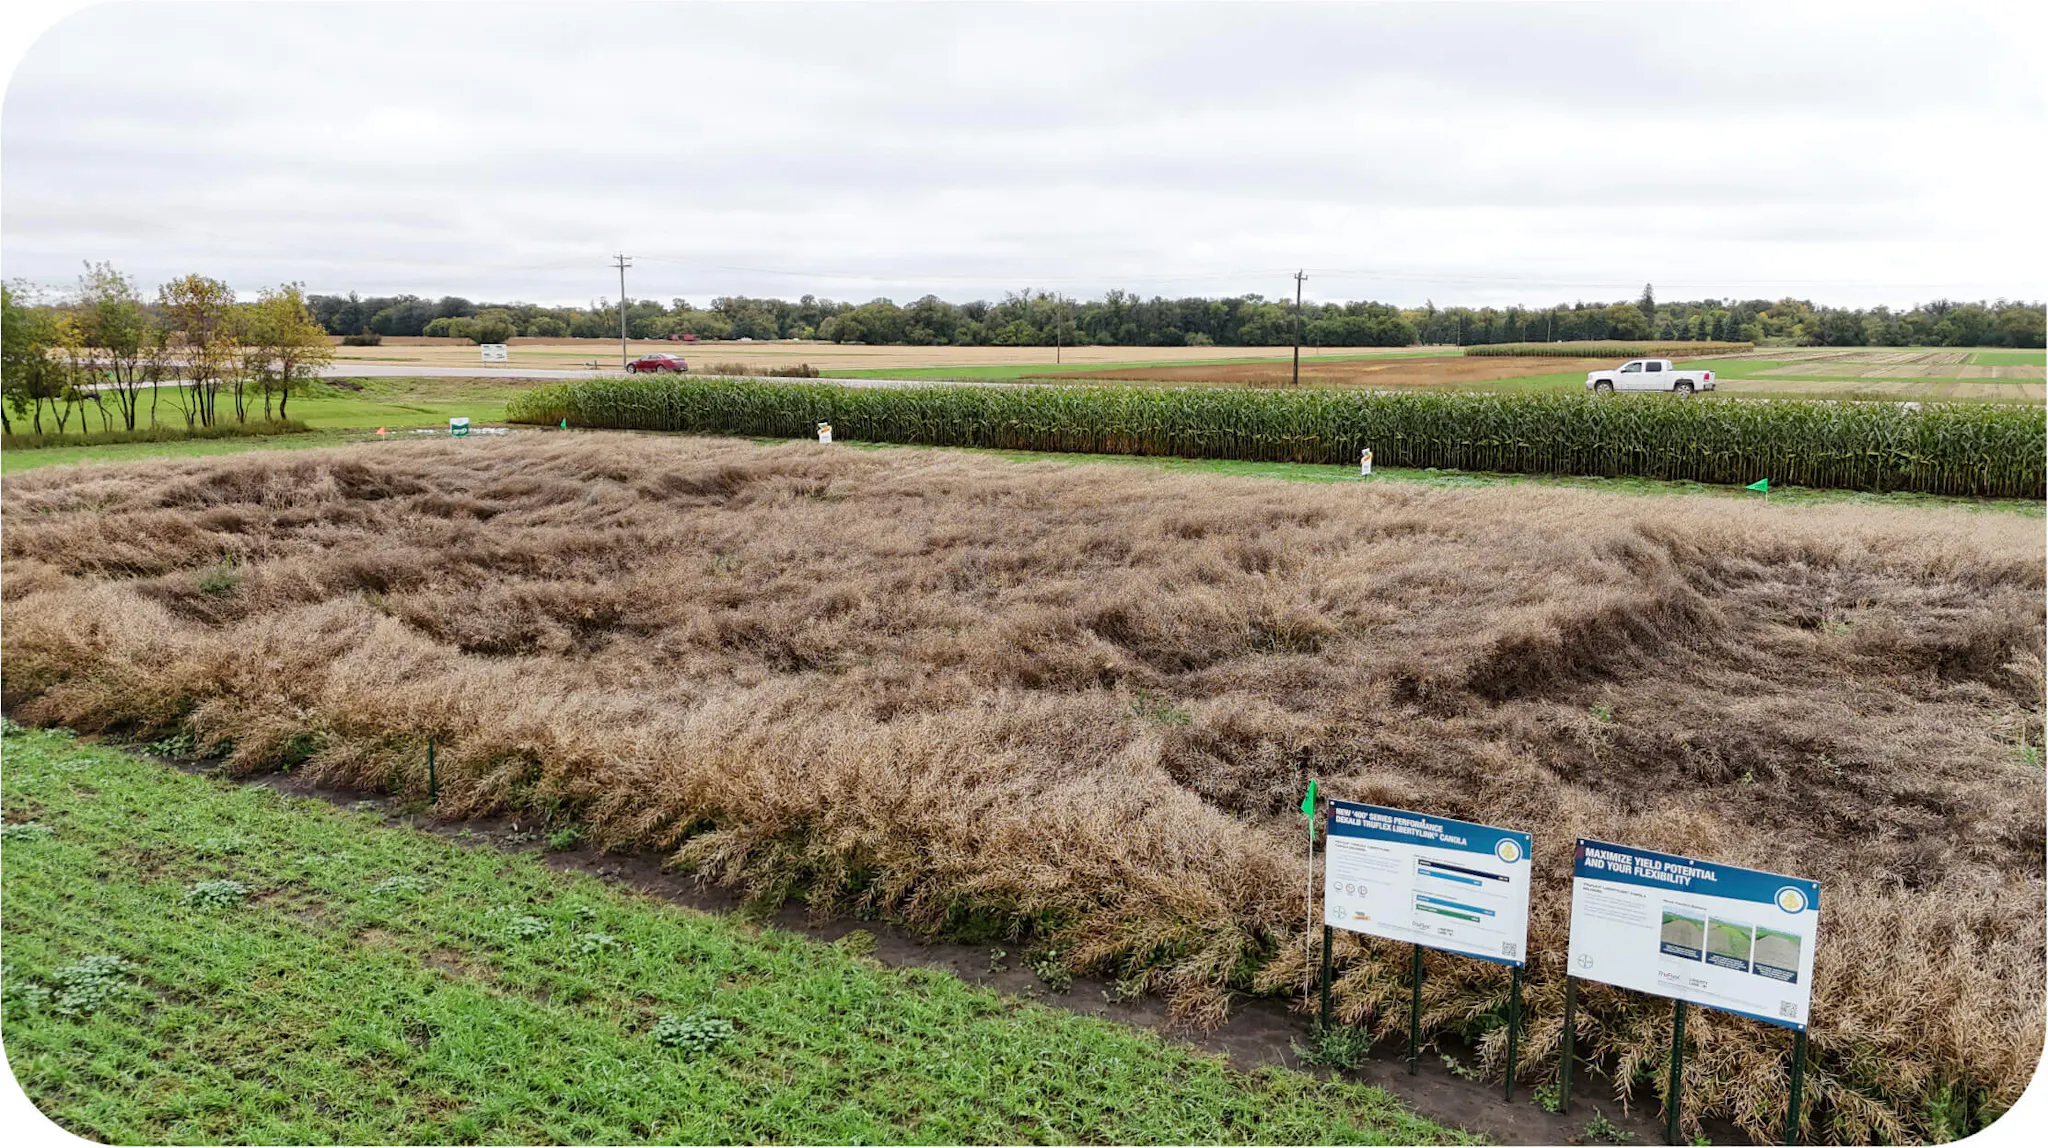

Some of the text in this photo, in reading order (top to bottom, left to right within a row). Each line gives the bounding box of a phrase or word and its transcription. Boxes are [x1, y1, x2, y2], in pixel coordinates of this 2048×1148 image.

[1363, 820, 1392, 831] TRUFLEX
[1439, 833, 1467, 846] CANOLA
[1369, 813, 1393, 823] SERIES
[1394, 817, 1443, 832] PERFORMANCE
[1584, 857, 1692, 886] AND YOUR FLEXIBILITY
[1585, 848, 1718, 882] MAXIMIZE YIELD POTENTIAL
